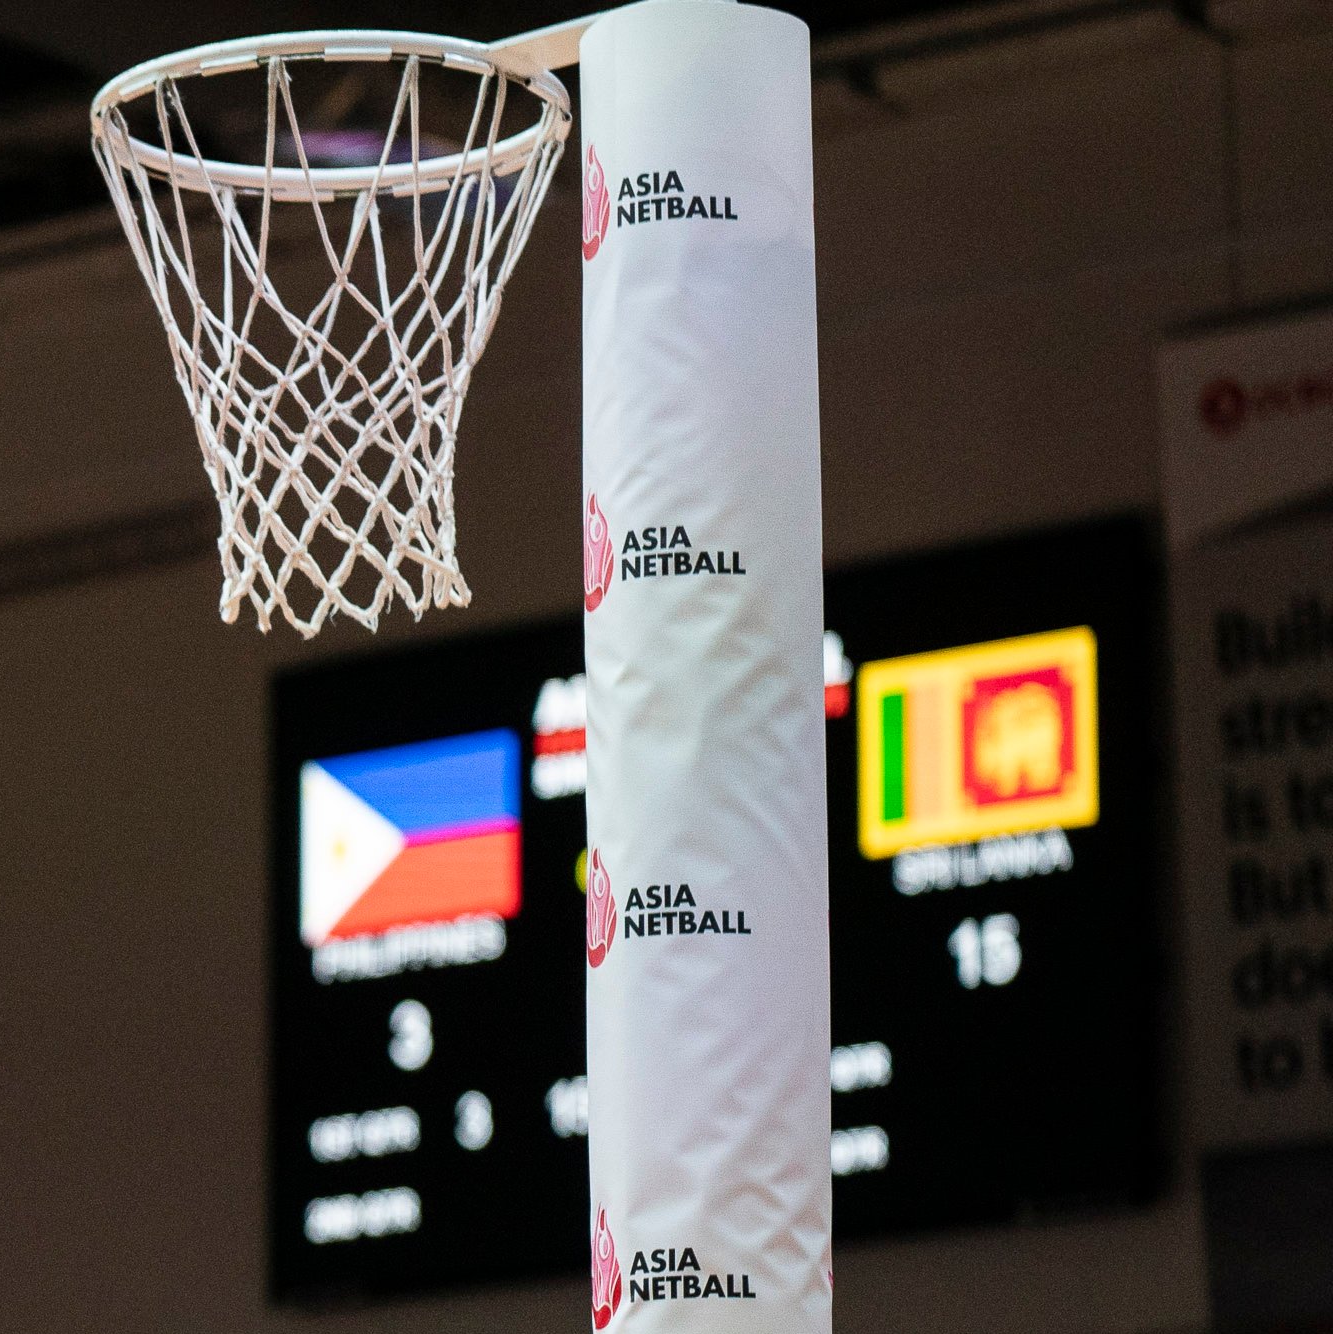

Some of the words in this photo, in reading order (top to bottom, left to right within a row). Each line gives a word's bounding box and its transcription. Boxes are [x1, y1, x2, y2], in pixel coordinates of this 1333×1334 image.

[617, 170, 685, 201] ASIA
[617, 195, 738, 228] NETBALL
[622, 525, 692, 555] ASIA
[621, 551, 747, 581] NETBALL
[624, 883, 697, 912] ASIA
[624, 910, 752, 939] NETBALL
[388, 998, 434, 1072] 3
[630, 1247, 702, 1276] ASIA
[629, 1273, 757, 1303] NETBALL
